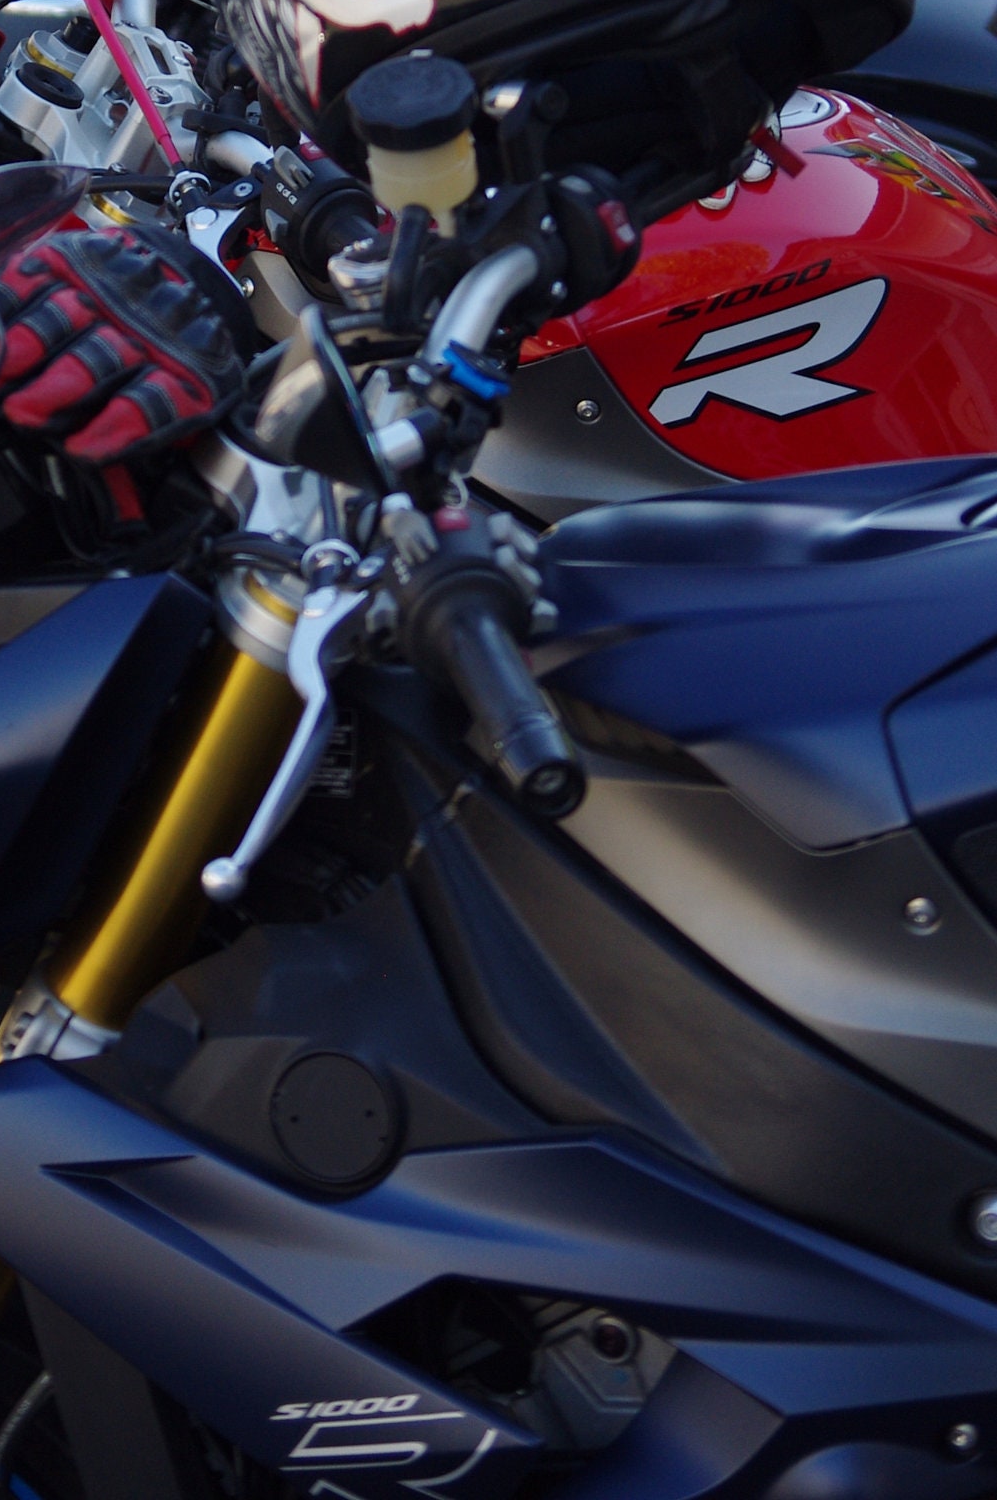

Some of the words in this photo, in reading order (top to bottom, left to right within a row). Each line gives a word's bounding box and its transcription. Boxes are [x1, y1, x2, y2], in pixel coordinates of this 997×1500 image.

[658, 257, 832, 329] S1000
[645, 274, 893, 426] R
[268, 1393, 420, 1421] S1000
